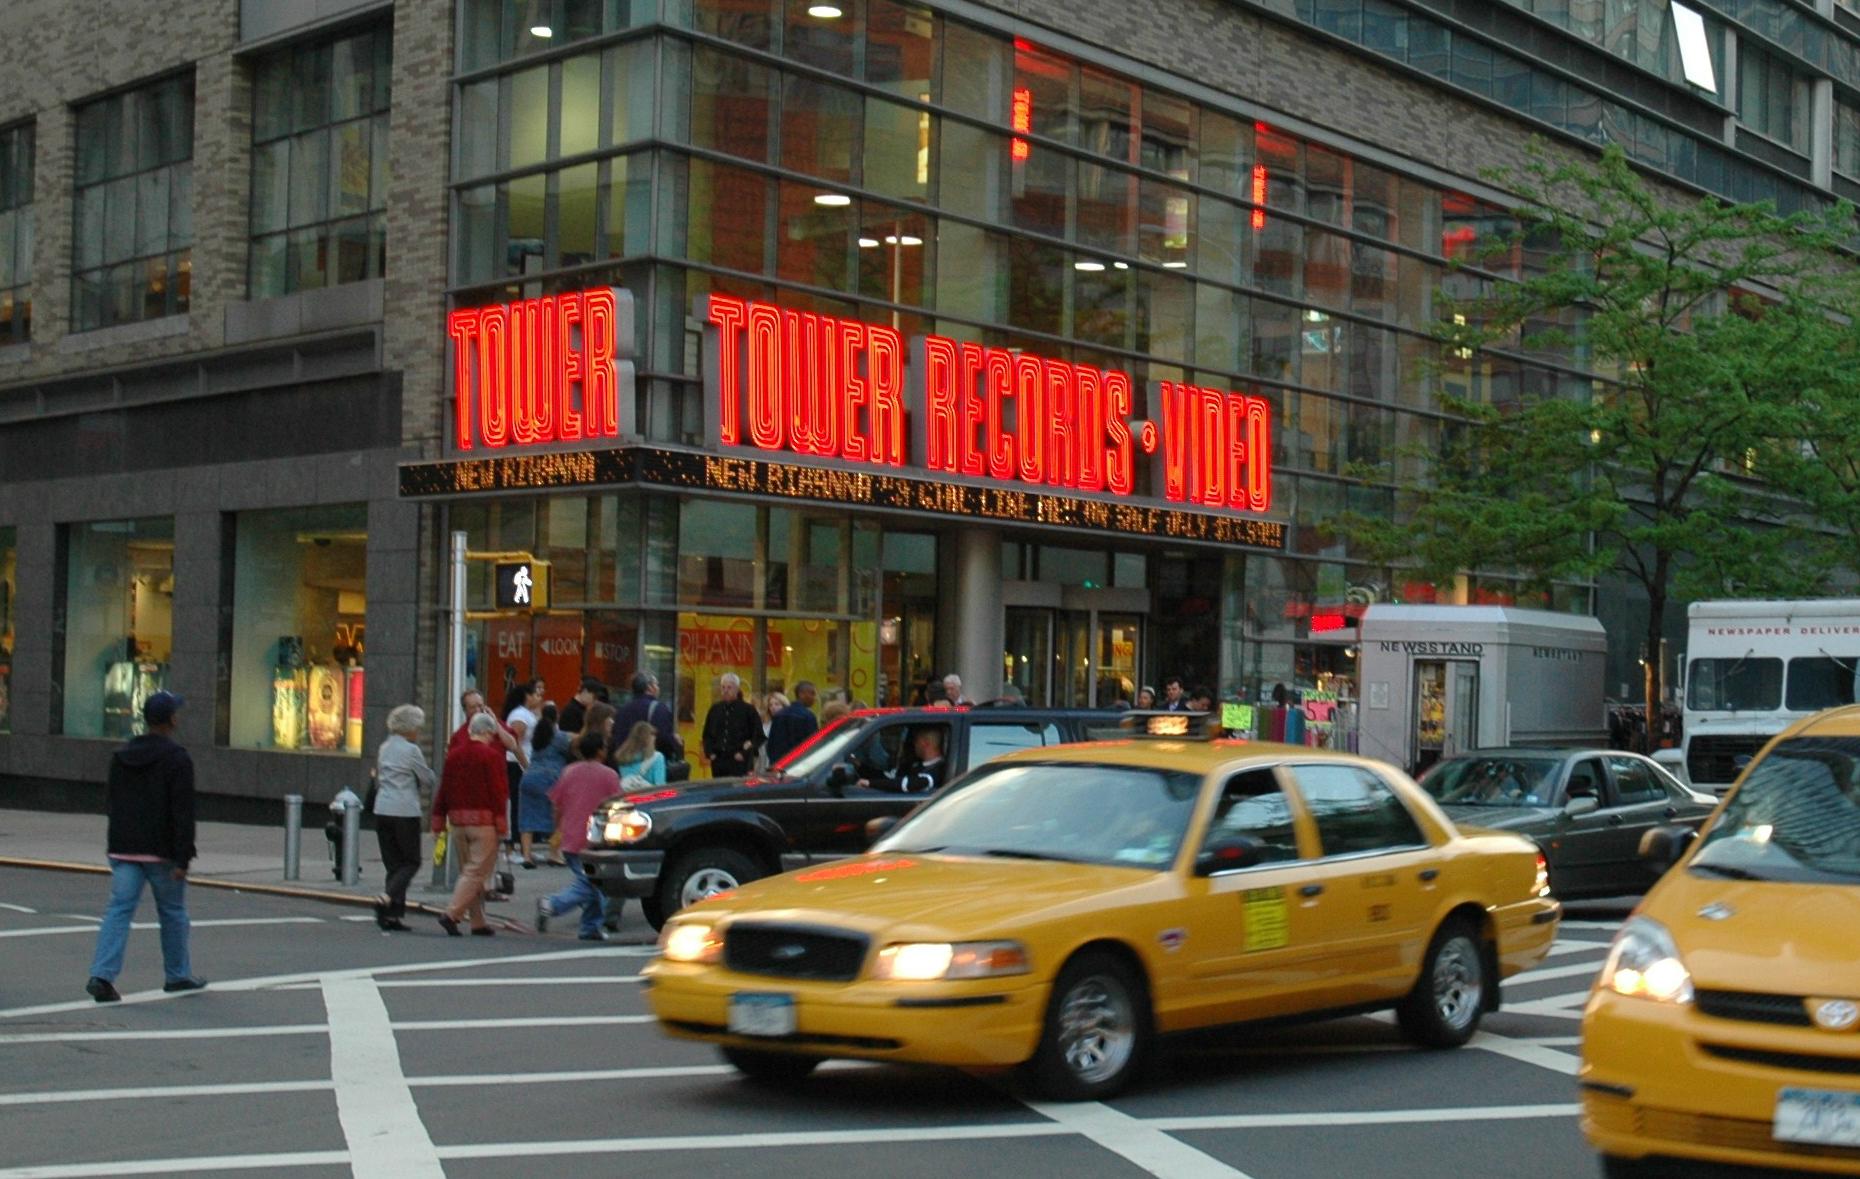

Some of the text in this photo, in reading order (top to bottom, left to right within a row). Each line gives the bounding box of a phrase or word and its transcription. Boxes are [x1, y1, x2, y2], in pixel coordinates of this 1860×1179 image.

[450, 286, 619, 450] TOWER
[709, 293, 1271, 513] TOWER RECORDS VIDEO
[453, 451, 597, 491] NEW RIHANNA
[704, 455, 758, 491] NEW
[768, 461, 872, 502] RIHANNA
[499, 631, 526, 659] EAT
[550, 637, 580, 656] LOOK
[1707, 626, 1792, 636] NEWSPAPER
[603, 643, 630, 663] STOP
[679, 630, 778, 665] RIHANNA
[1380, 640, 1484, 655] NEWSSTAND
